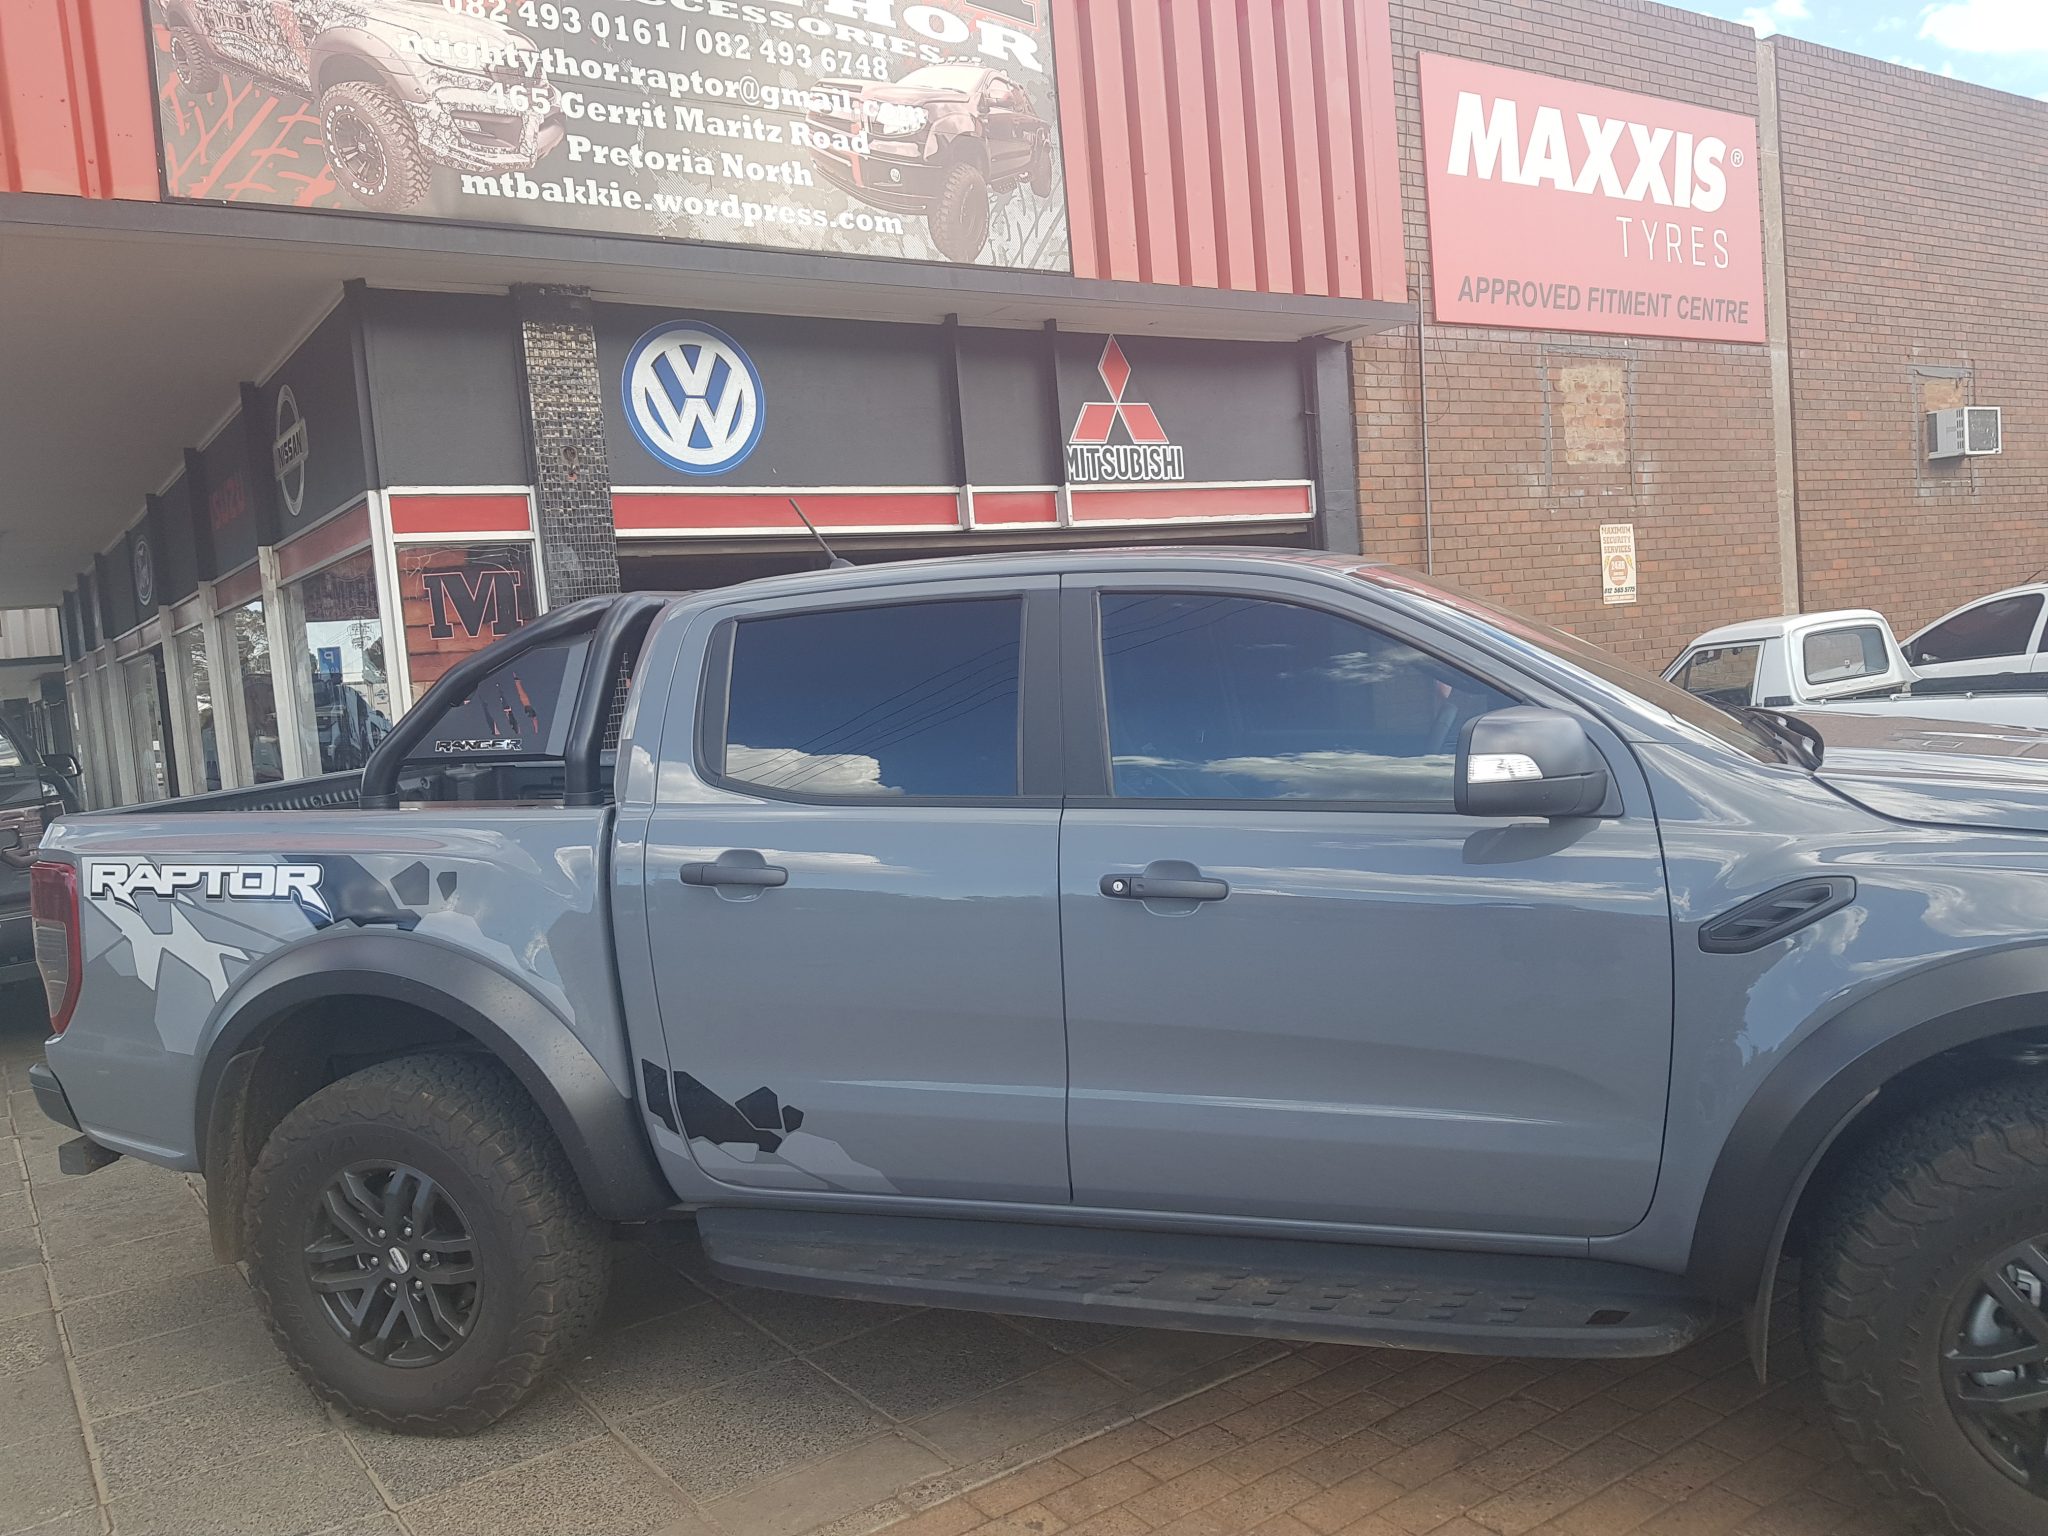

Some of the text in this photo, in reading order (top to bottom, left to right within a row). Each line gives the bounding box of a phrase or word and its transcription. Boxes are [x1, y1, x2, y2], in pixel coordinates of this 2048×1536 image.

[442, 0, 508, 23] 082
[518, 1, 582, 34] 493
[591, 11, 670, 48] 0161
[695, 28, 751, 60] 082
[759, 38, 813, 69] 493
[820, 48, 889, 80] 6748
[618, 0, 943, 63] CESSORIES
[768, 0, 1043, 72] HOR
[486, 82, 871, 155] 465 Gerrit Maritz Road
[566, 134, 814, 187] Pretoria North
[1446, 91, 1728, 213] MAXXIS
[460, 171, 904, 235] mtbakkie.wordpress.com
[1616, 216, 1730, 270] TYRES
[1457, 275, 1749, 324] APPROVED FITMENT CENTRE
[277, 429, 303, 470] NISSAN
[1066, 445, 1185, 481] MITSUBISHI
[434, 738, 522, 753] RANGER
[91, 863, 335, 923] RAPTOR
